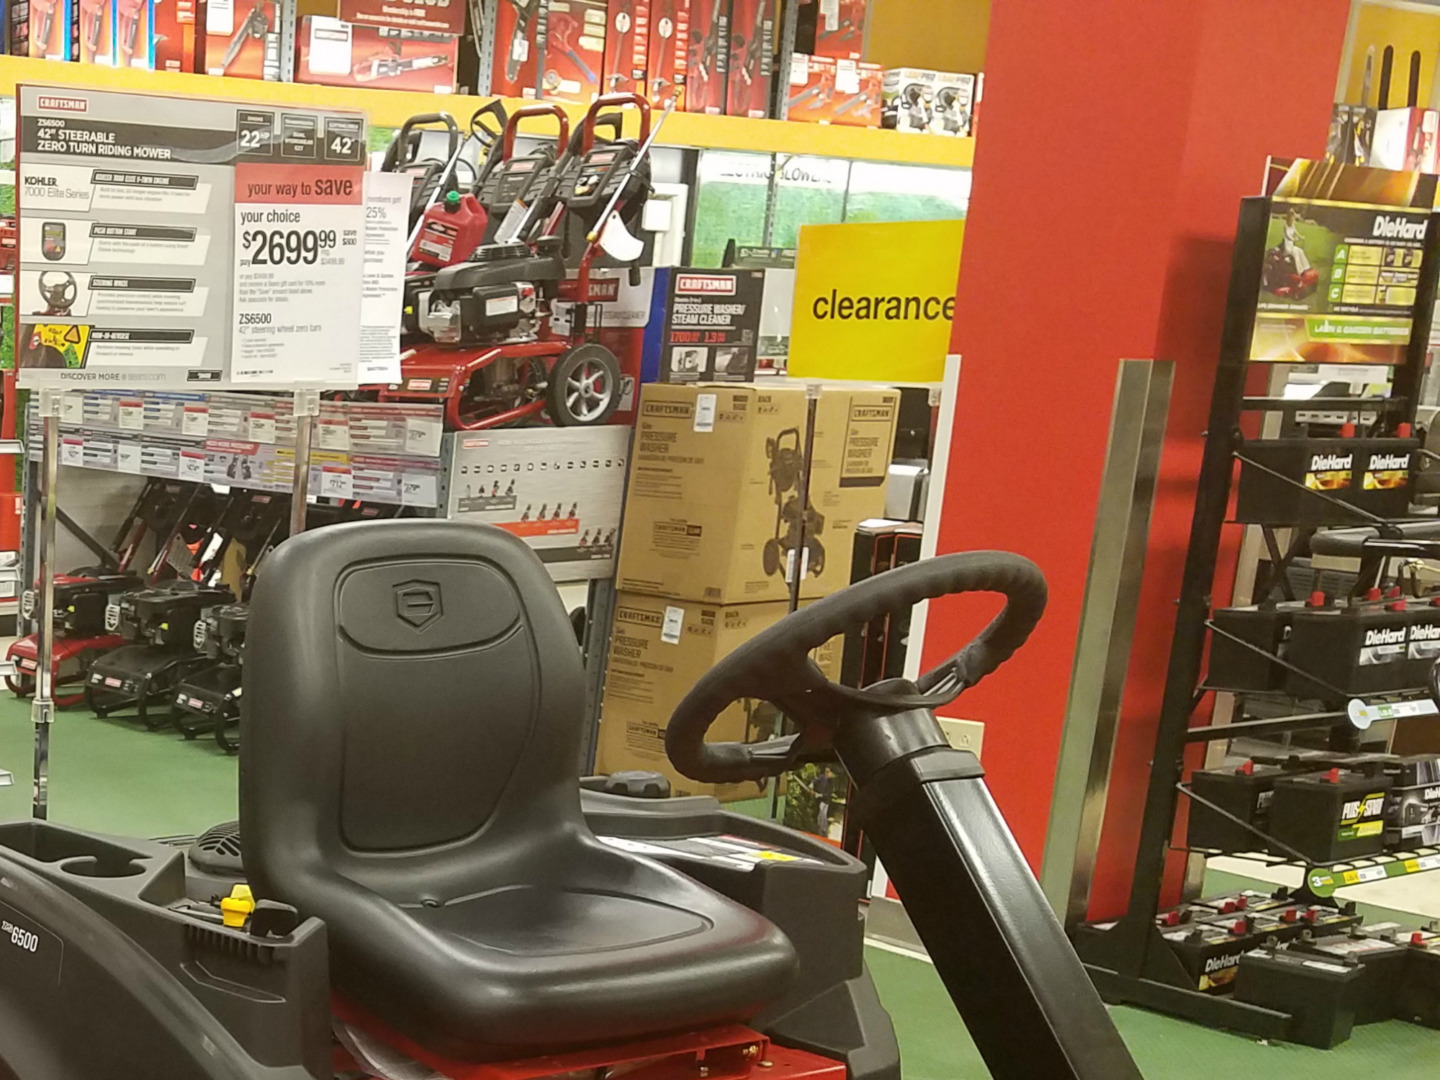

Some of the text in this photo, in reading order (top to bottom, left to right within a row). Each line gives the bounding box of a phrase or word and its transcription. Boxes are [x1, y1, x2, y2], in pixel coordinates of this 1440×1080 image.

[40, 98, 86, 110] CRAFTSMAN
[37, 119, 65, 127] ZS6500
[38, 128, 116, 143] 42" STEERABLE
[38, 140, 171, 159] ZERO TURN RIDING MOWER
[24, 187, 46, 197] 7000
[66, 189, 89, 200] Series
[247, 179, 353, 198] your way to save
[241, 209, 300, 225] your choice
[366, 206, 387, 219] 25%
[1372, 215, 1428, 239] DieHard
[679, 278, 733, 291] CRAFTSMAN
[673, 304, 713, 314] PRESSURE
[812, 288, 956, 322] clearance
[239, 313, 272, 325] ZS6500
[671, 314, 732, 325] STEAM CLEANER
[296, 324, 322, 333] zero turn
[61, 372, 120, 381] DISCOVER MORE
[646, 404, 690, 414] CRAFTSMAN
[854, 409, 889, 417] CRAFTSMAN
[1311, 453, 1353, 471] DieHard
[1368, 453, 1410, 470] DieHard
[1365, 627, 1407, 646] DieHard
[1410, 624, 1440, 640] DieHar
